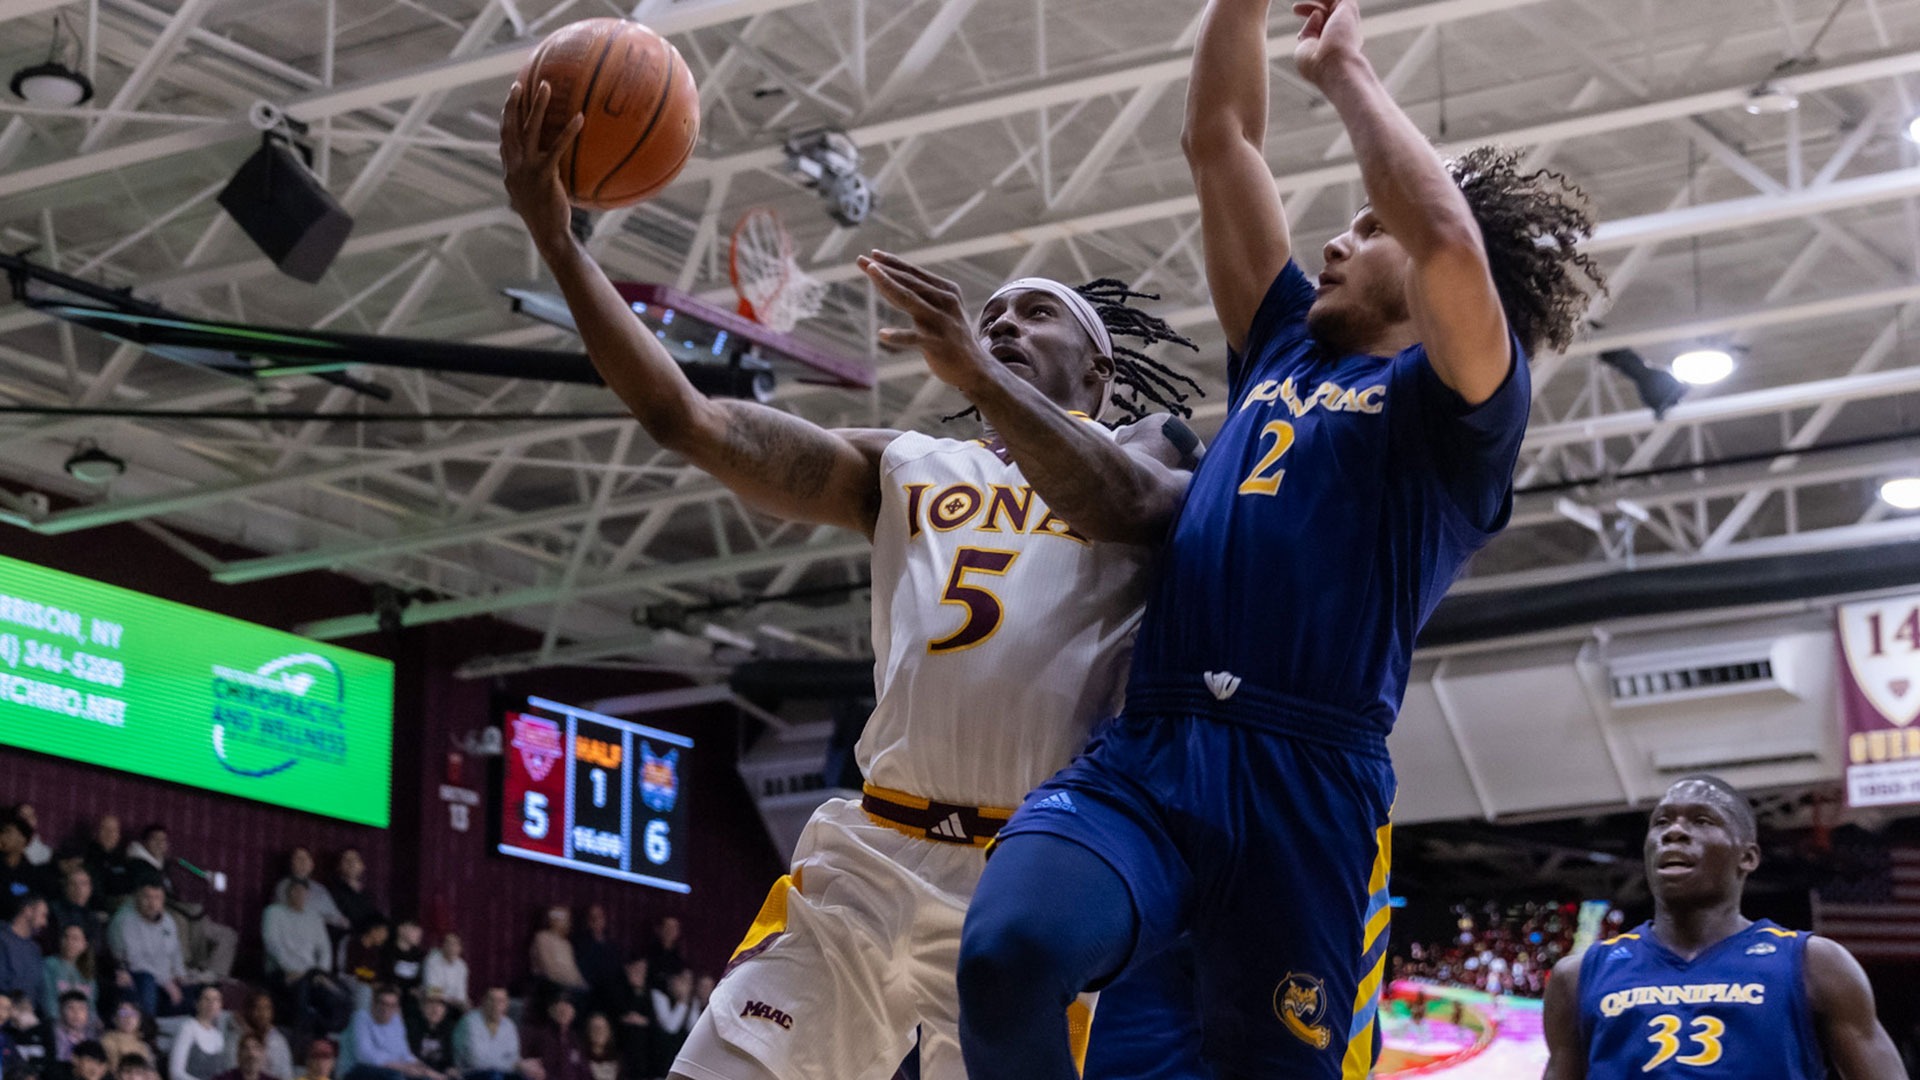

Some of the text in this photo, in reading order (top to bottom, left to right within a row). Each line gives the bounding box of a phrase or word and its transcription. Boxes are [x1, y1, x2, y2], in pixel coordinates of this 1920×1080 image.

[1238, 419, 1295, 497] 2
[927, 545, 1021, 655] 5
[91, 617, 123, 649] NY
[1867, 607, 1920, 657] 14
[212, 677, 346, 730] CHIROPRACTIC
[213, 705, 253, 733] AND
[259, 716, 347, 757] WELLNESS
[575, 735, 622, 769] HALF
[589, 768, 607, 808] 1
[522, 790, 549, 839] 5
[643, 818, 671, 865] 6
[739, 1000, 793, 1030] MAAC
[1600, 983, 1765, 1017] QUINNIPIAC
[1642, 1014, 1725, 1073] 33
